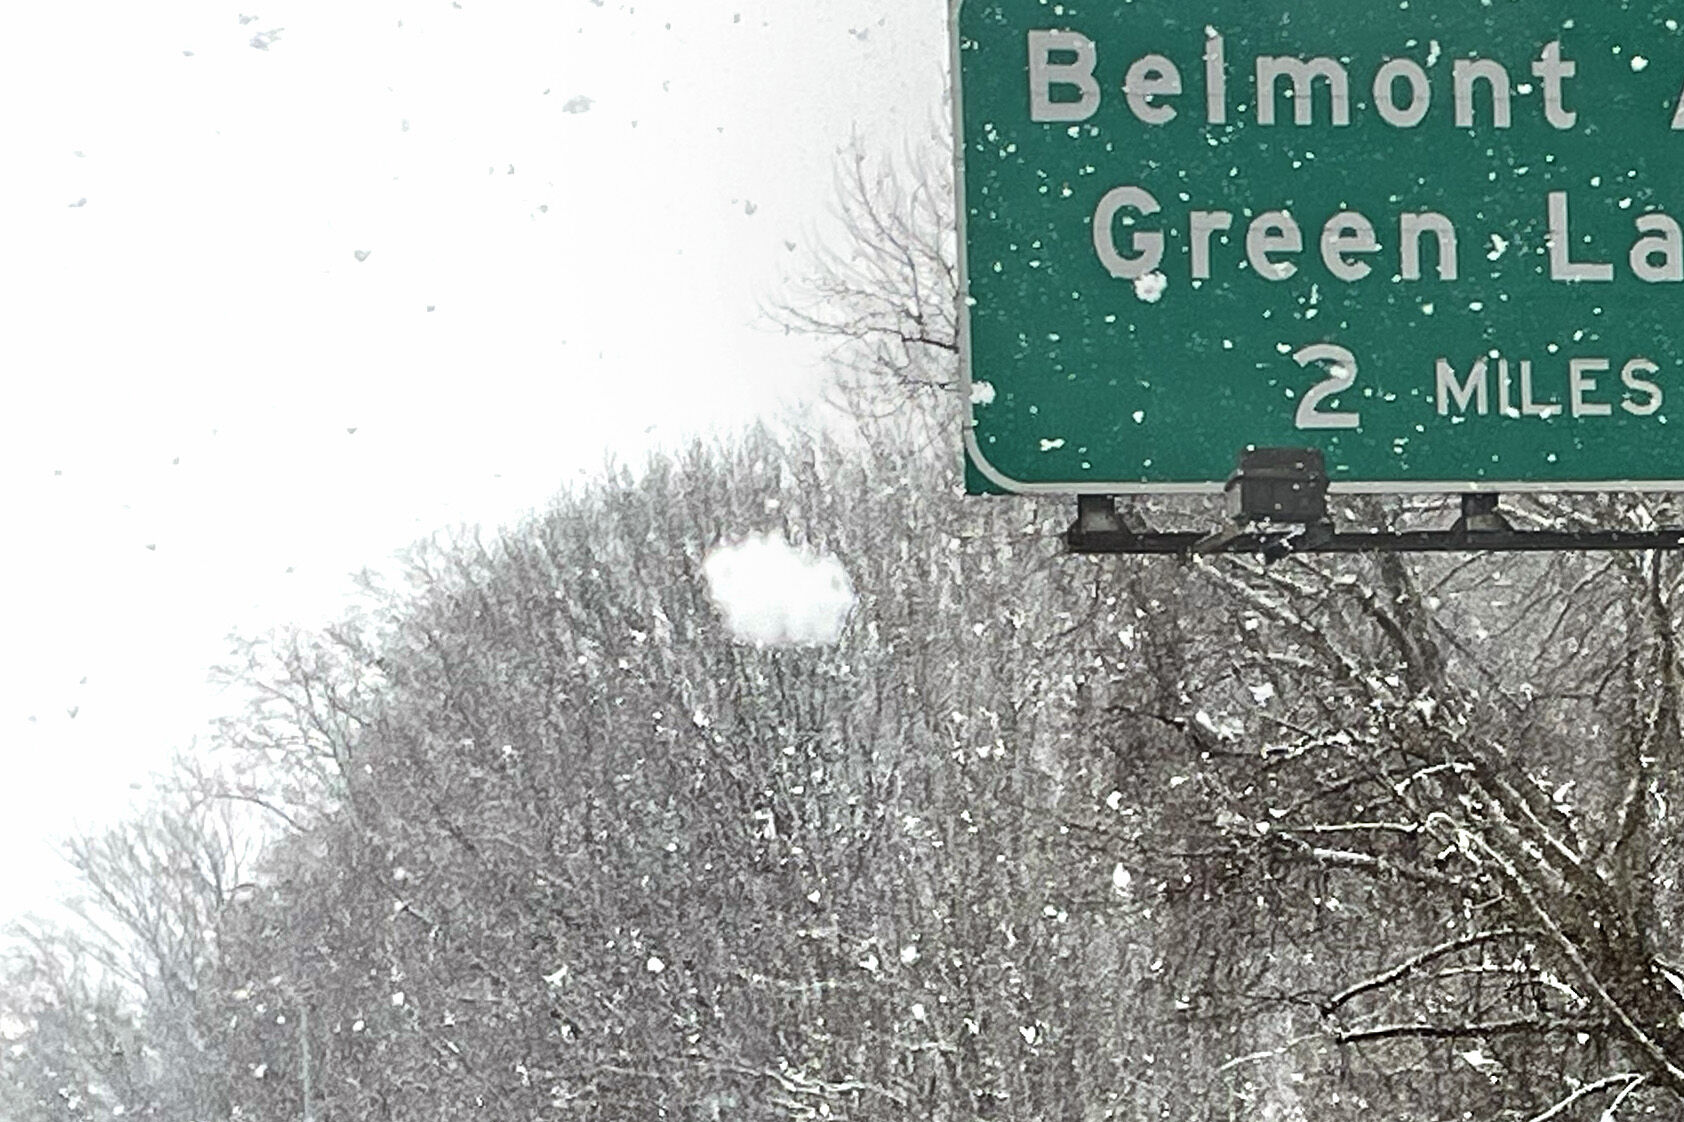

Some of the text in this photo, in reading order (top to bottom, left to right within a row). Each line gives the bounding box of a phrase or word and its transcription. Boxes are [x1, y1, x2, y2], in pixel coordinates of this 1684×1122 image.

[1028, 29, 1577, 129] Belmont
[1094, 187, 1458, 282] Green
[1293, 344, 1663, 430] 2 MILES
